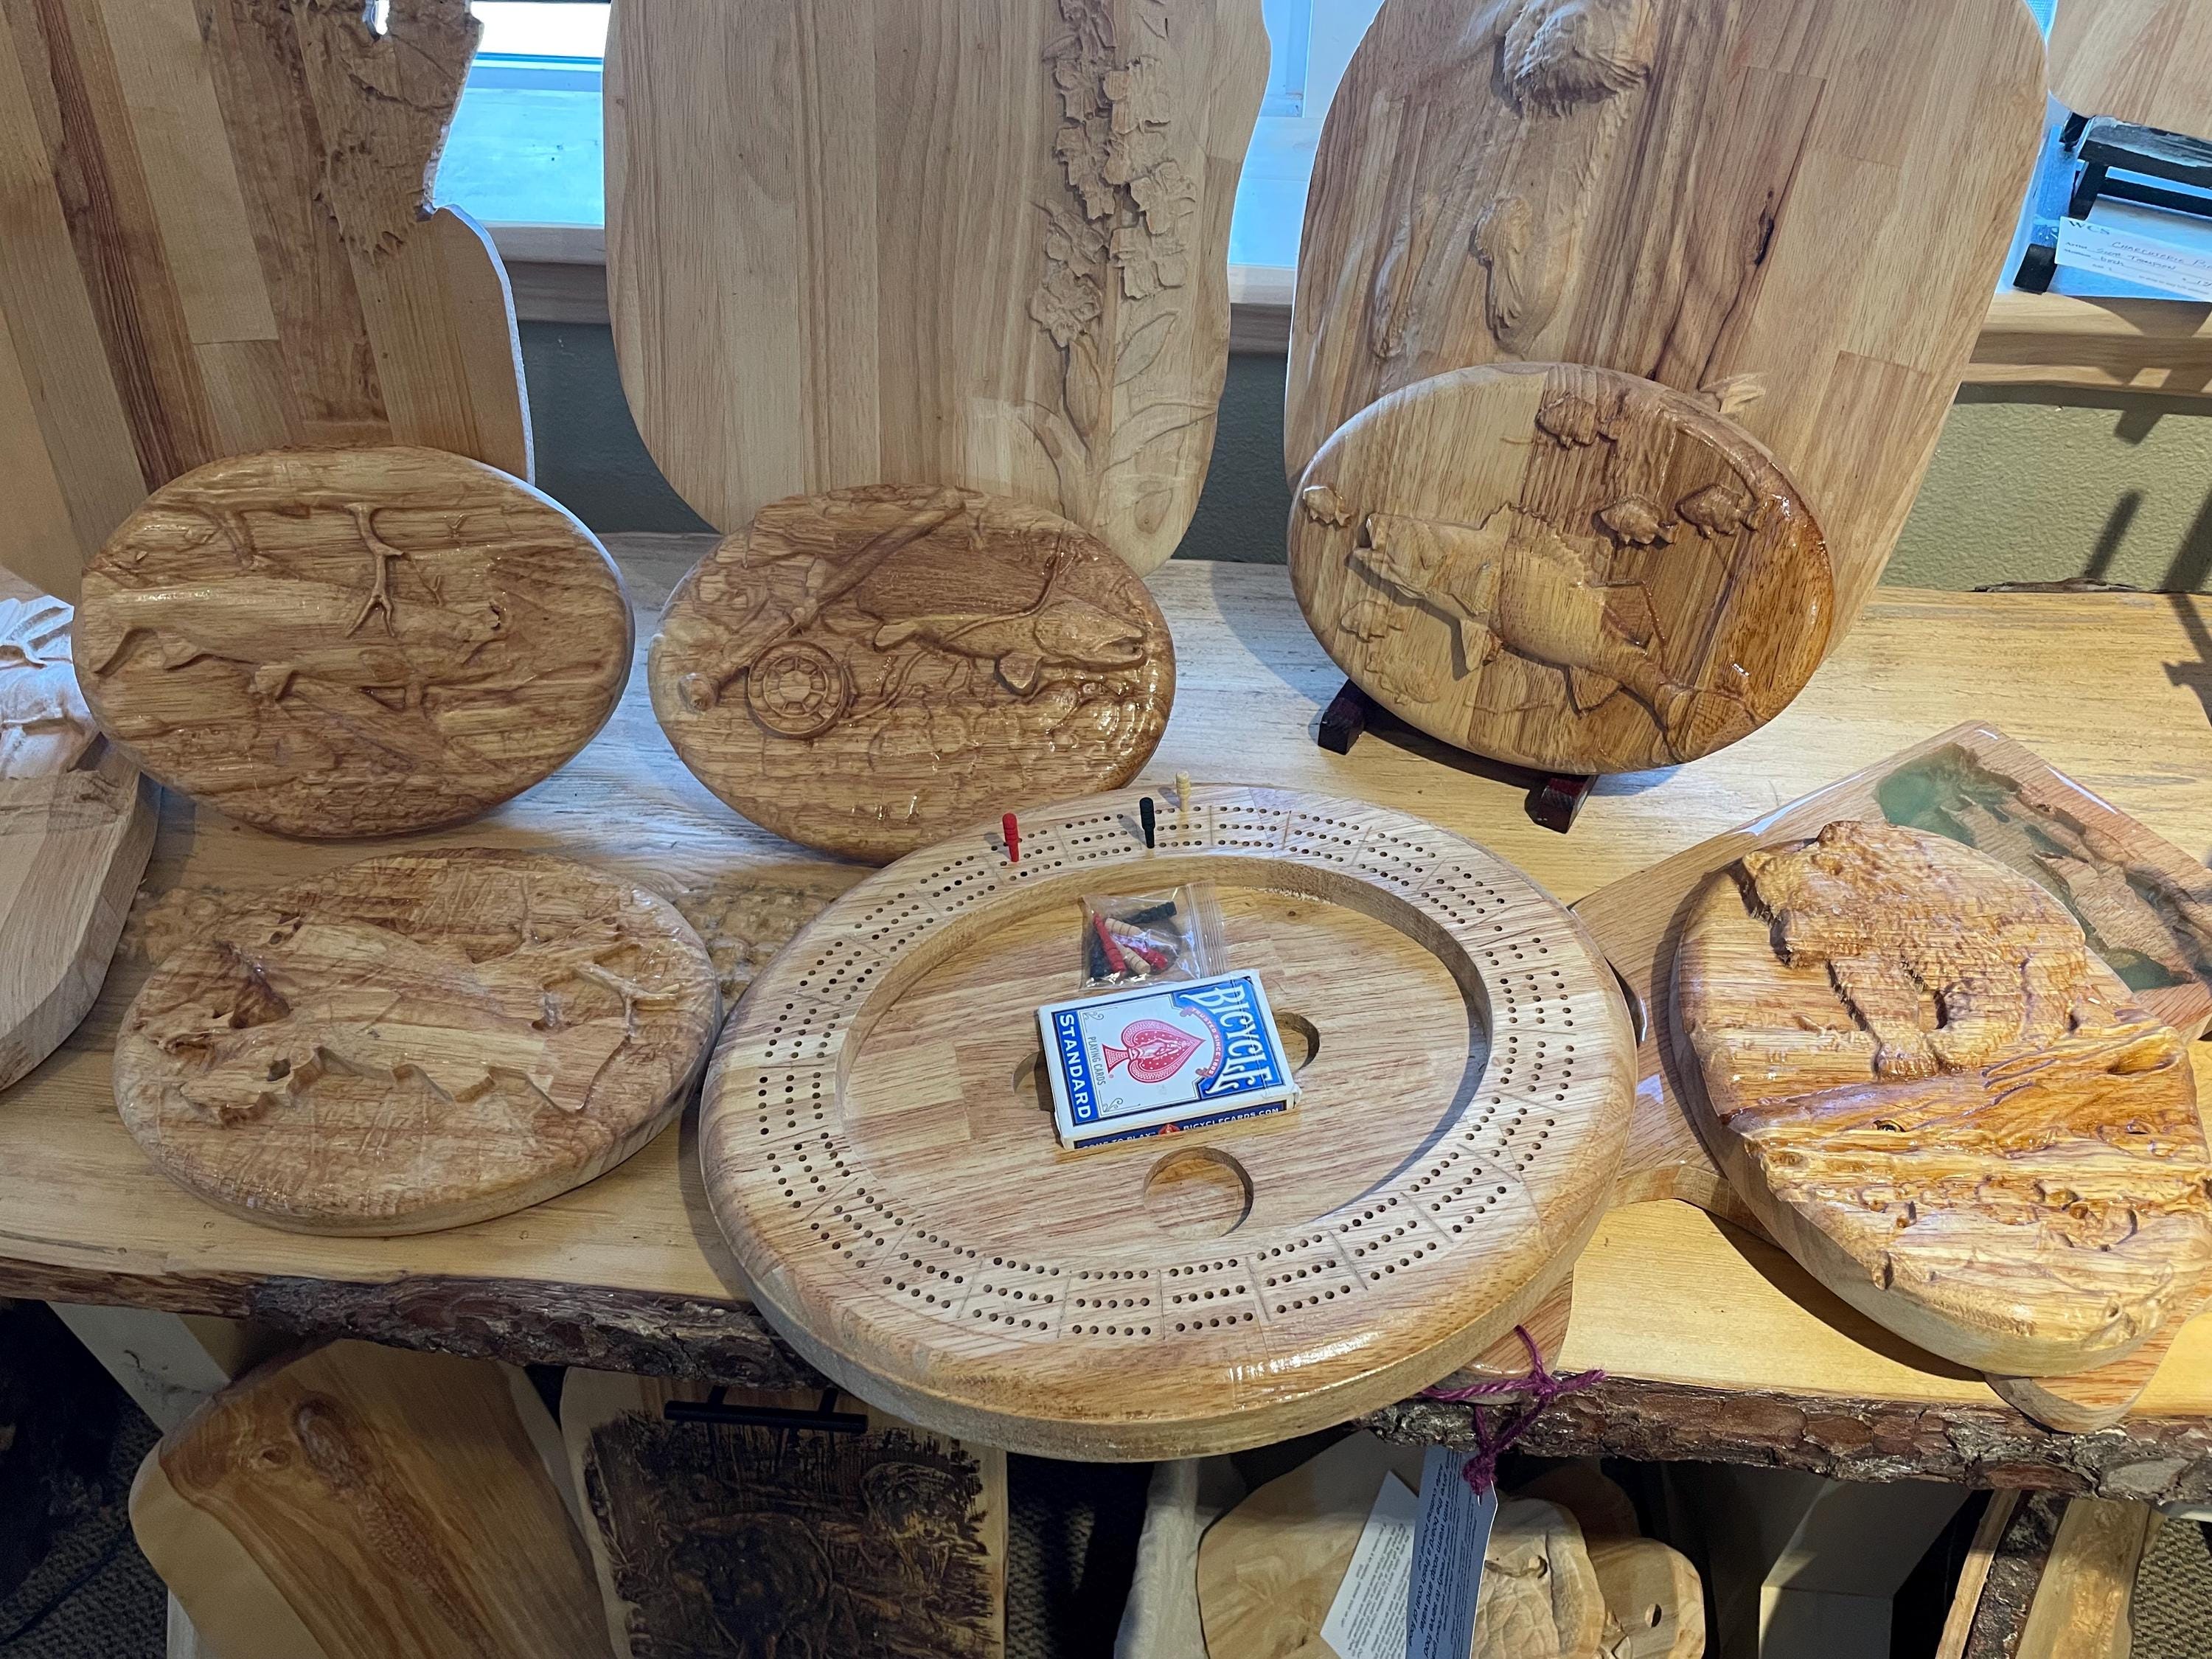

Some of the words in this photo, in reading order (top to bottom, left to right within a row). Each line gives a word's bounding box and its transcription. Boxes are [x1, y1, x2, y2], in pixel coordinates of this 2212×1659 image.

[2067, 220, 2110, 234] WCS
[1088, 1036, 1102, 1062] PLAYING
[1180, 985, 1273, 1094] BICYCLE
[1191, 1006, 1217, 1034] TRUSTED
[1208, 1057, 1220, 1075] 1885
[1060, 1014, 1091, 1119] STANDARD
[1094, 1063, 1106, 1086] CARDS
[1427, 1487, 1437, 1523] cutting
[1420, 1523, 1429, 1556] board
[1429, 1515, 1439, 1550] board
[1436, 1523, 1445, 1554] warm
[1427, 1547, 1433, 1557] a
[1421, 1557, 1430, 1585] fresh
[1430, 1554, 1439, 1581] soap
[1437, 1557, 1445, 1589] ready
[1415, 1585, 1424, 1610] coat
[1435, 1589, 1441, 1602] to
[1412, 1608, 1419, 1624] of
[1419, 1604, 1428, 1635] water
[1429, 1601, 1438, 1632] serve
[1408, 1620, 1416, 1647] food
[1423, 1632, 1433, 1659] food
